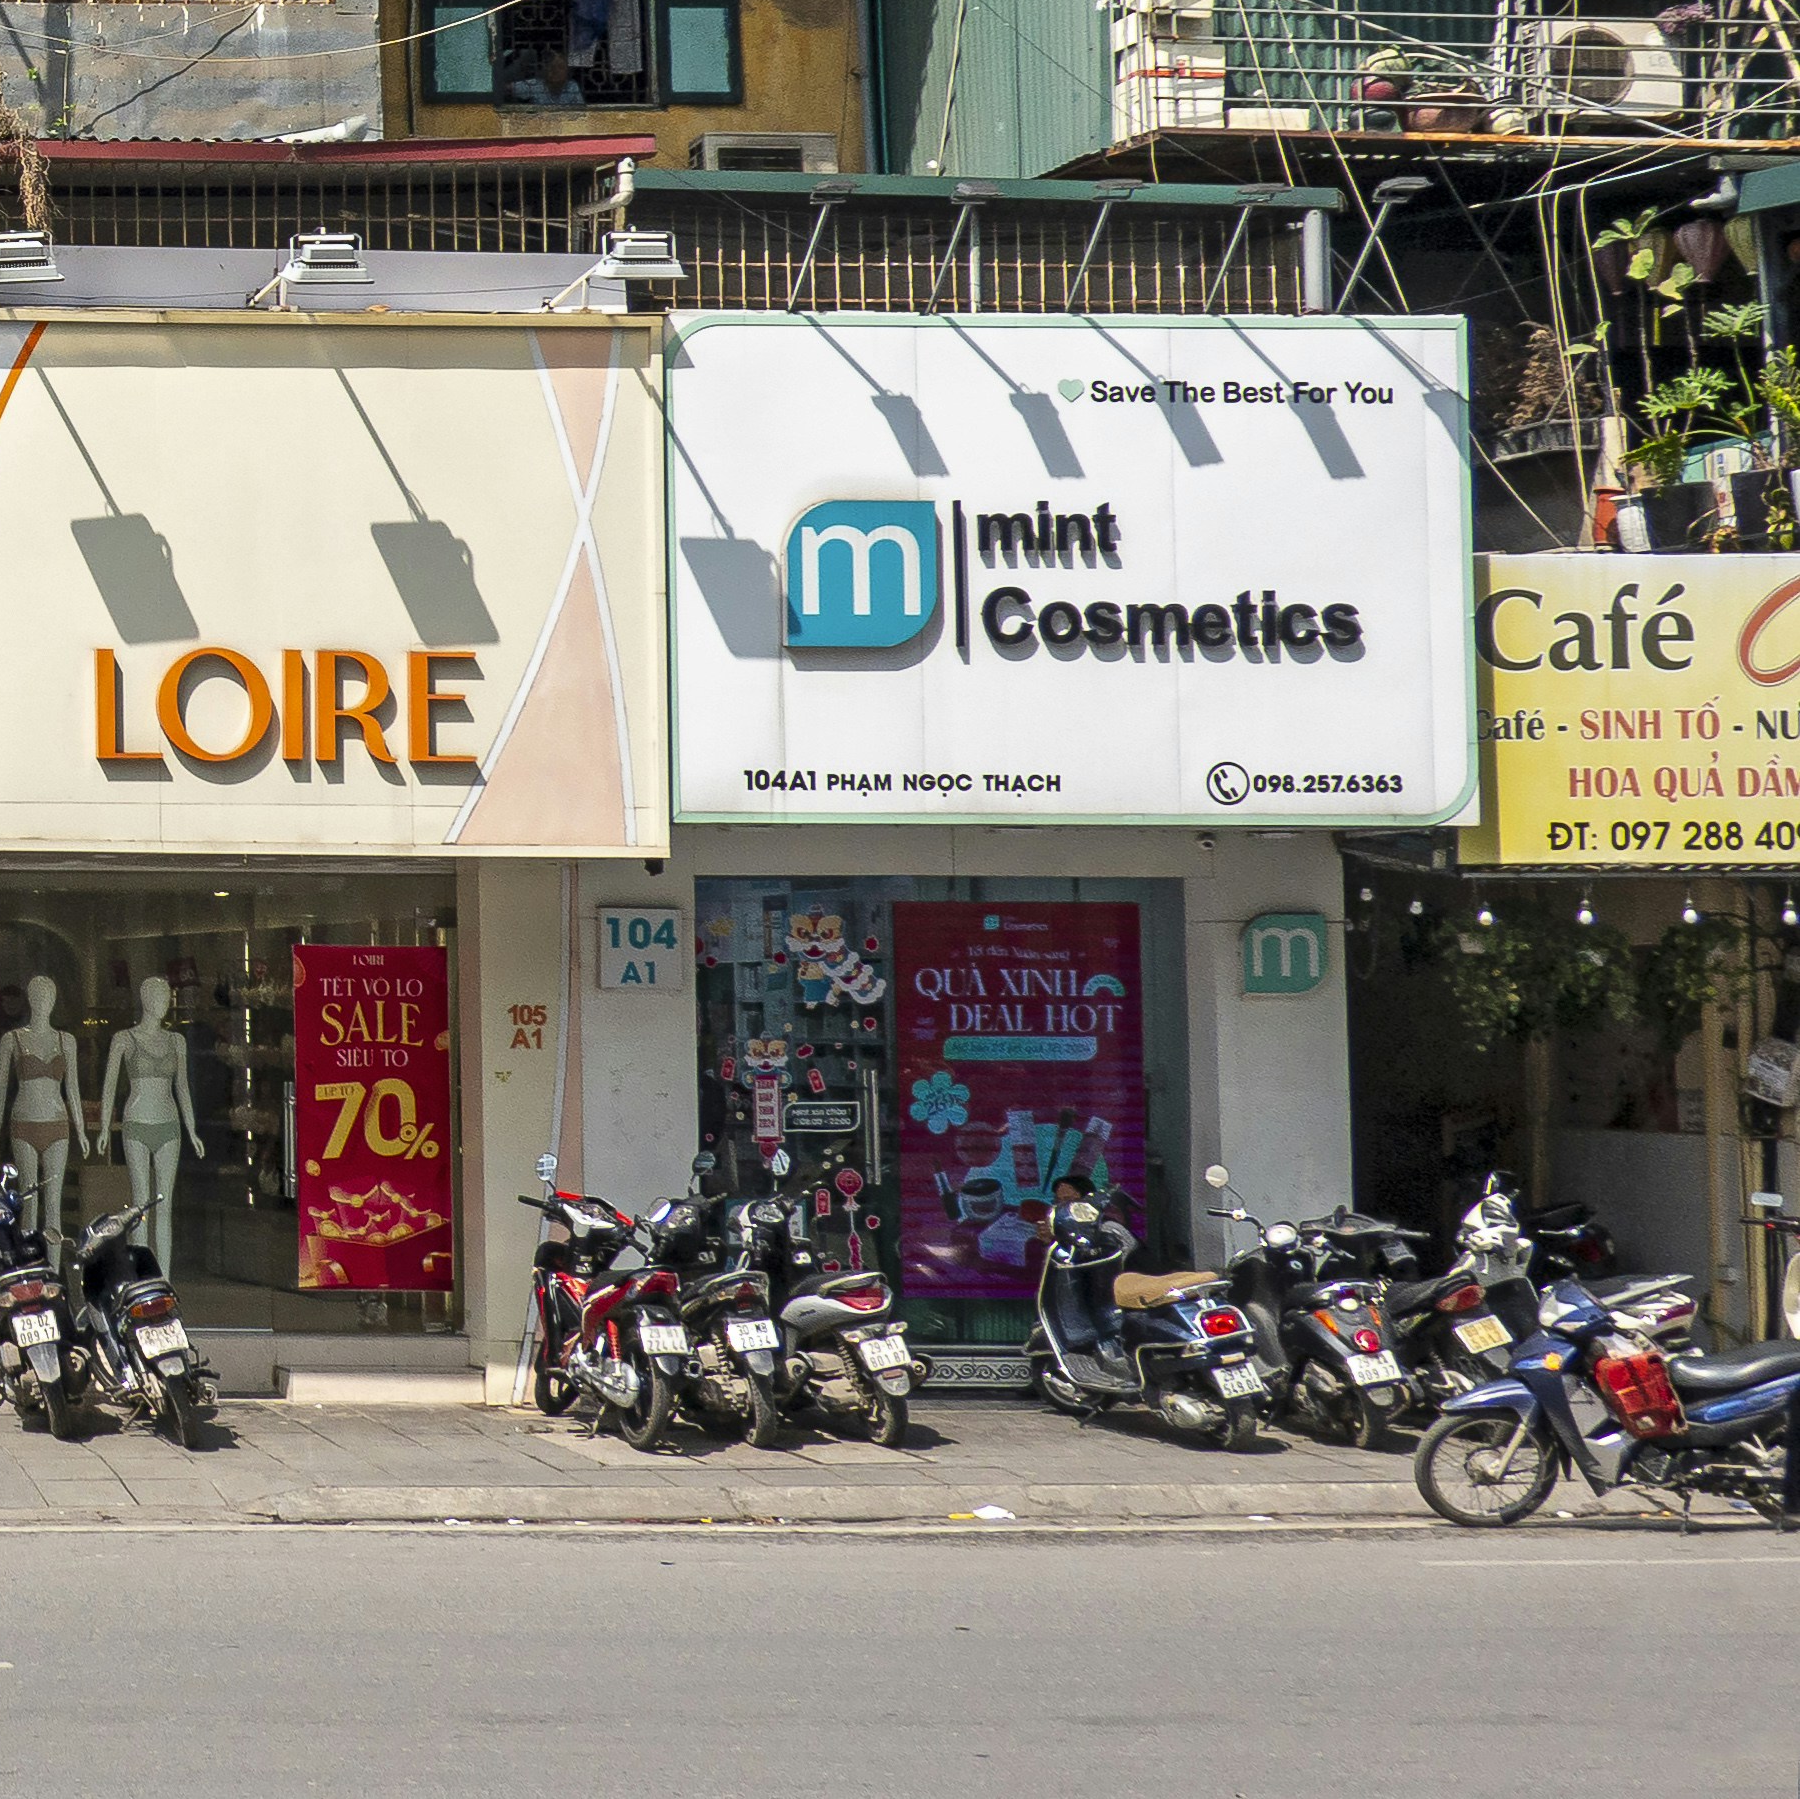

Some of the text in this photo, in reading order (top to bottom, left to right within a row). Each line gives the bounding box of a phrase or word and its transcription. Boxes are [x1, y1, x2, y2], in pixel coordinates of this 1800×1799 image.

[1090, 380, 1394, 406] Save The Best For You
[800, 500, 1119, 617] m mint
[982, 586, 1362, 648] Cosmetics
[1475, 582, 1696, 672] Café
[93, 647, 480, 764] LOIRE
[1477, 695, 1721, 741] Café SINH TỐ
[744, 769, 1061, 798] 104A1 PHẠM NGỌC THẠCH
[1253, 774, 1404, 794] 098.257.6363
[1569, 767, 1641, 798] HOA
[1653, 750, 1724, 803] QUẢ
[1547, 821, 1800, 851] ĐT: 097 288 40
[605, 916, 679, 950] 104
[396, 978, 423, 998] LO
[620, 960, 657, 985] A1
[915, 961, 1081, 1001] QUÀ XINH
[319, 999, 425, 1047] SALE
[507, 1004, 548, 1027] 105
[949, 1003, 1035, 1033] DEAL
[1044, 1003, 1124, 1034] HOT
[509, 1027, 542, 1050] A1
[335, 1046, 409, 1068] SIÊU TO
[314, 1077, 440, 1161] 70%
